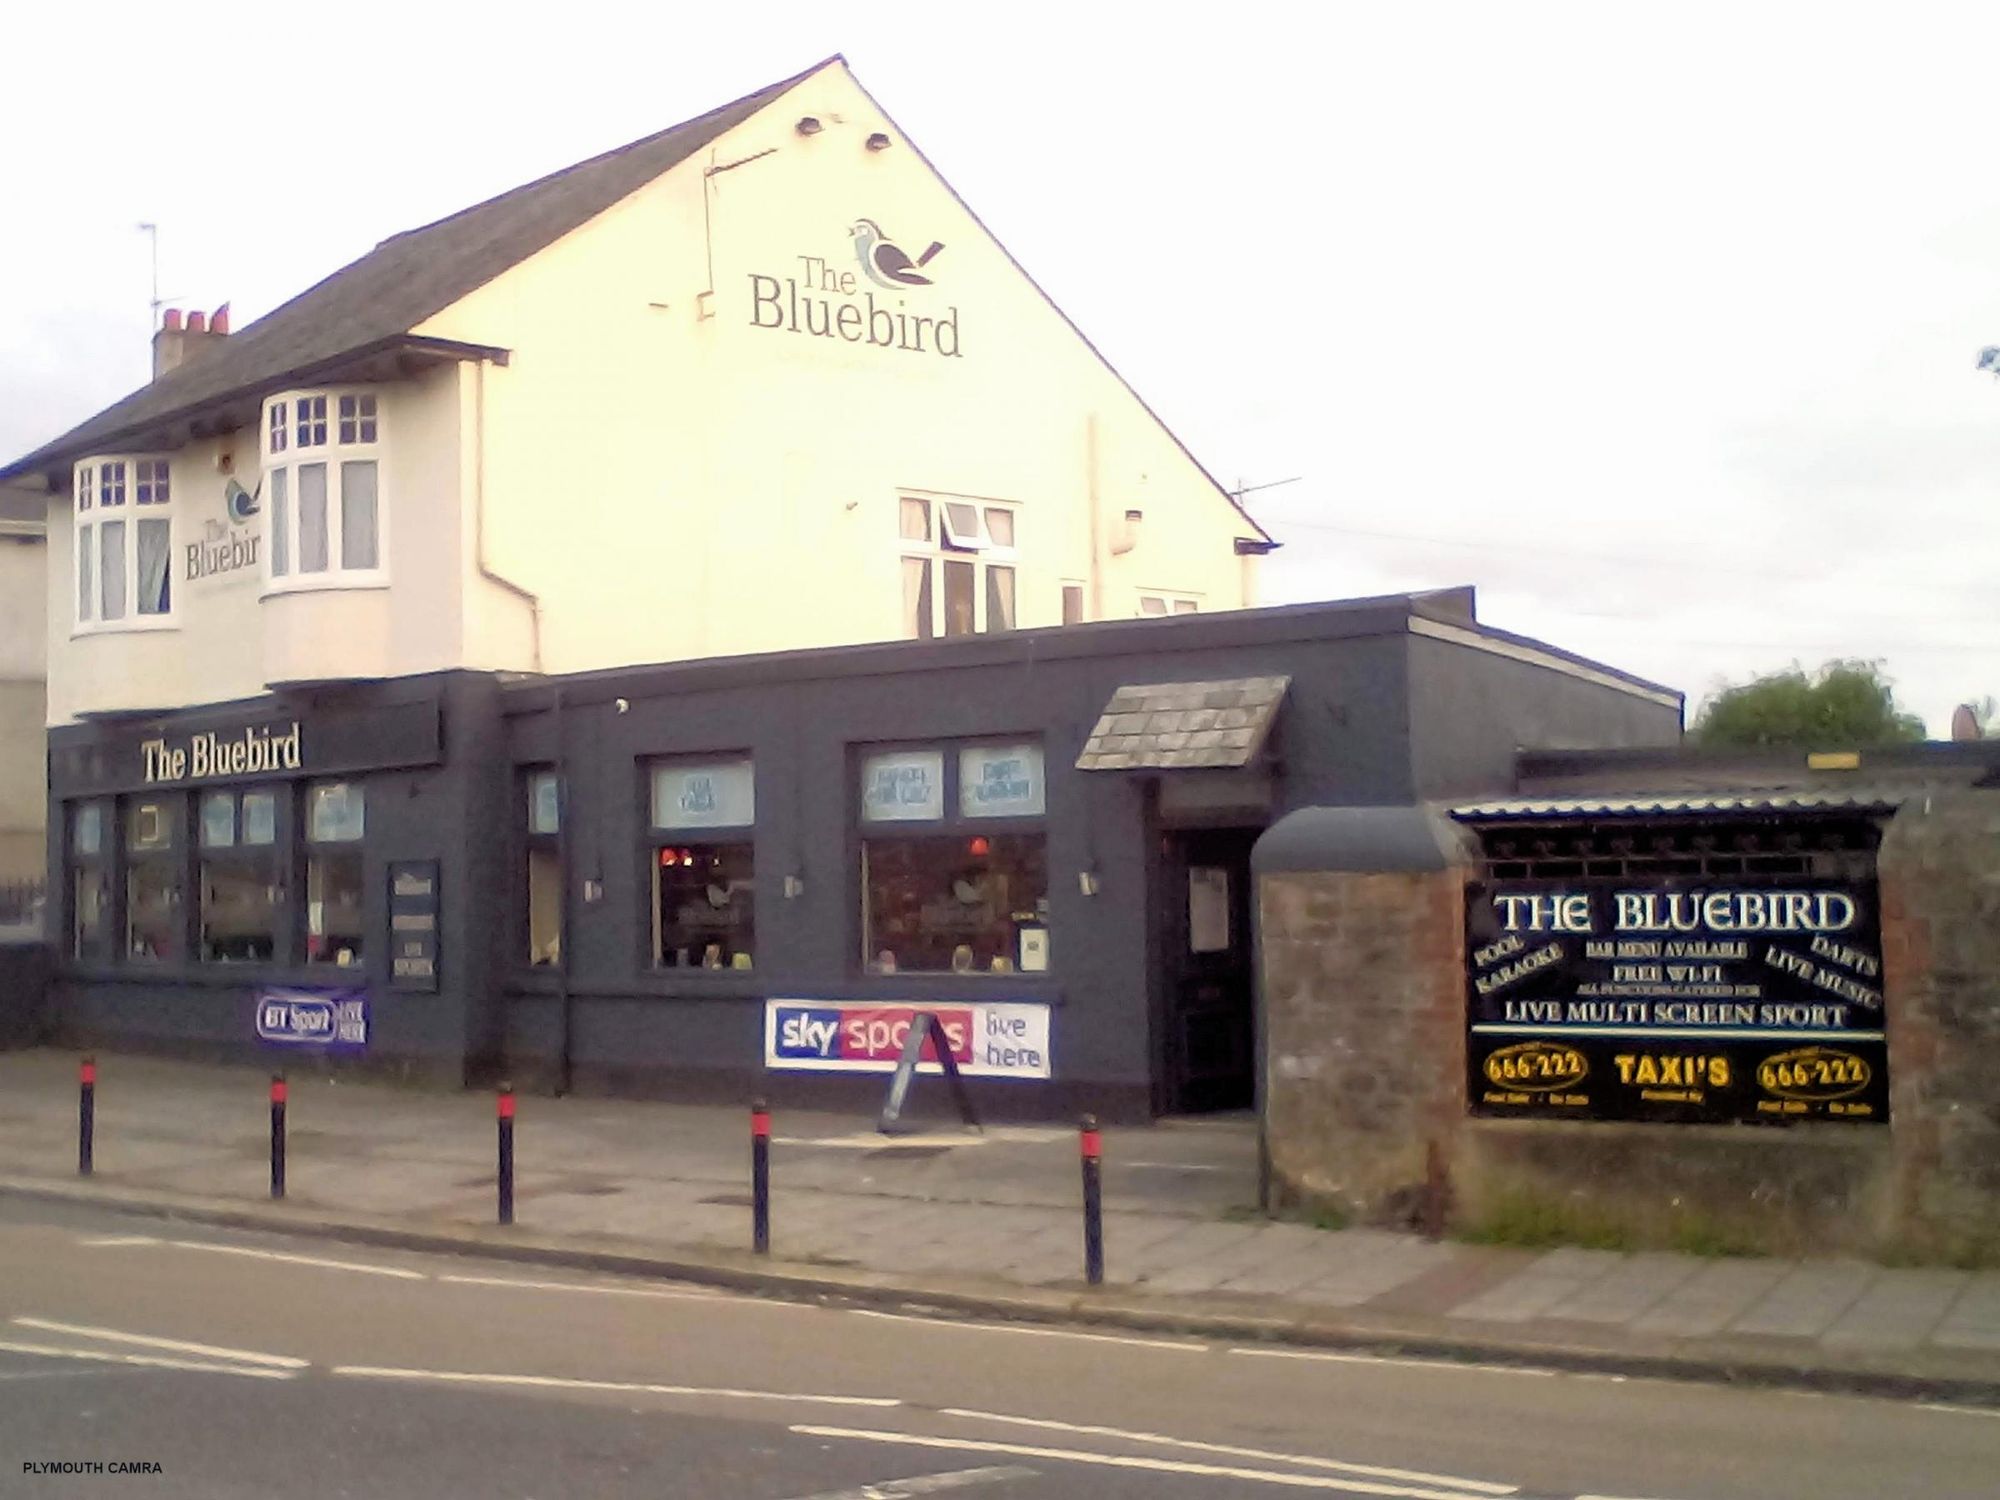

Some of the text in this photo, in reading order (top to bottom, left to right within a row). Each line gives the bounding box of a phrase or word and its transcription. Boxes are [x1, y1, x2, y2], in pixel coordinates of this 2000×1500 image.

[797, 255, 858, 296] The
[747, 273, 964, 358] Bluebird
[185, 530, 261, 580] Bluebir
[141, 721, 303, 782] The Bluebird
[1493, 892, 1856, 932] THE BLUEBIRD
[1473, 934, 1525, 968] POOL
[1585, 941, 1748, 960] BAR MENU AVAILABLE
[1810, 935, 1879, 977] DARTS
[1474, 942, 1564, 994] KARAOKE
[1613, 965, 1662, 982] FREE
[1764, 943, 1882, 1010] LIVE MUSIC
[265, 1006, 288, 1028] BT
[986, 1010, 1026, 1037] live
[1504, 1001, 1848, 1026] LIVE MULTI SCREEN SPORT
[782, 1012, 964, 1056] sky spos
[986, 1041, 1040, 1067] here
[1489, 1051, 1580, 1079] 666-222
[1614, 1055, 1731, 1087] TAXI'S
[1762, 1058, 1864, 1088] 666-222
